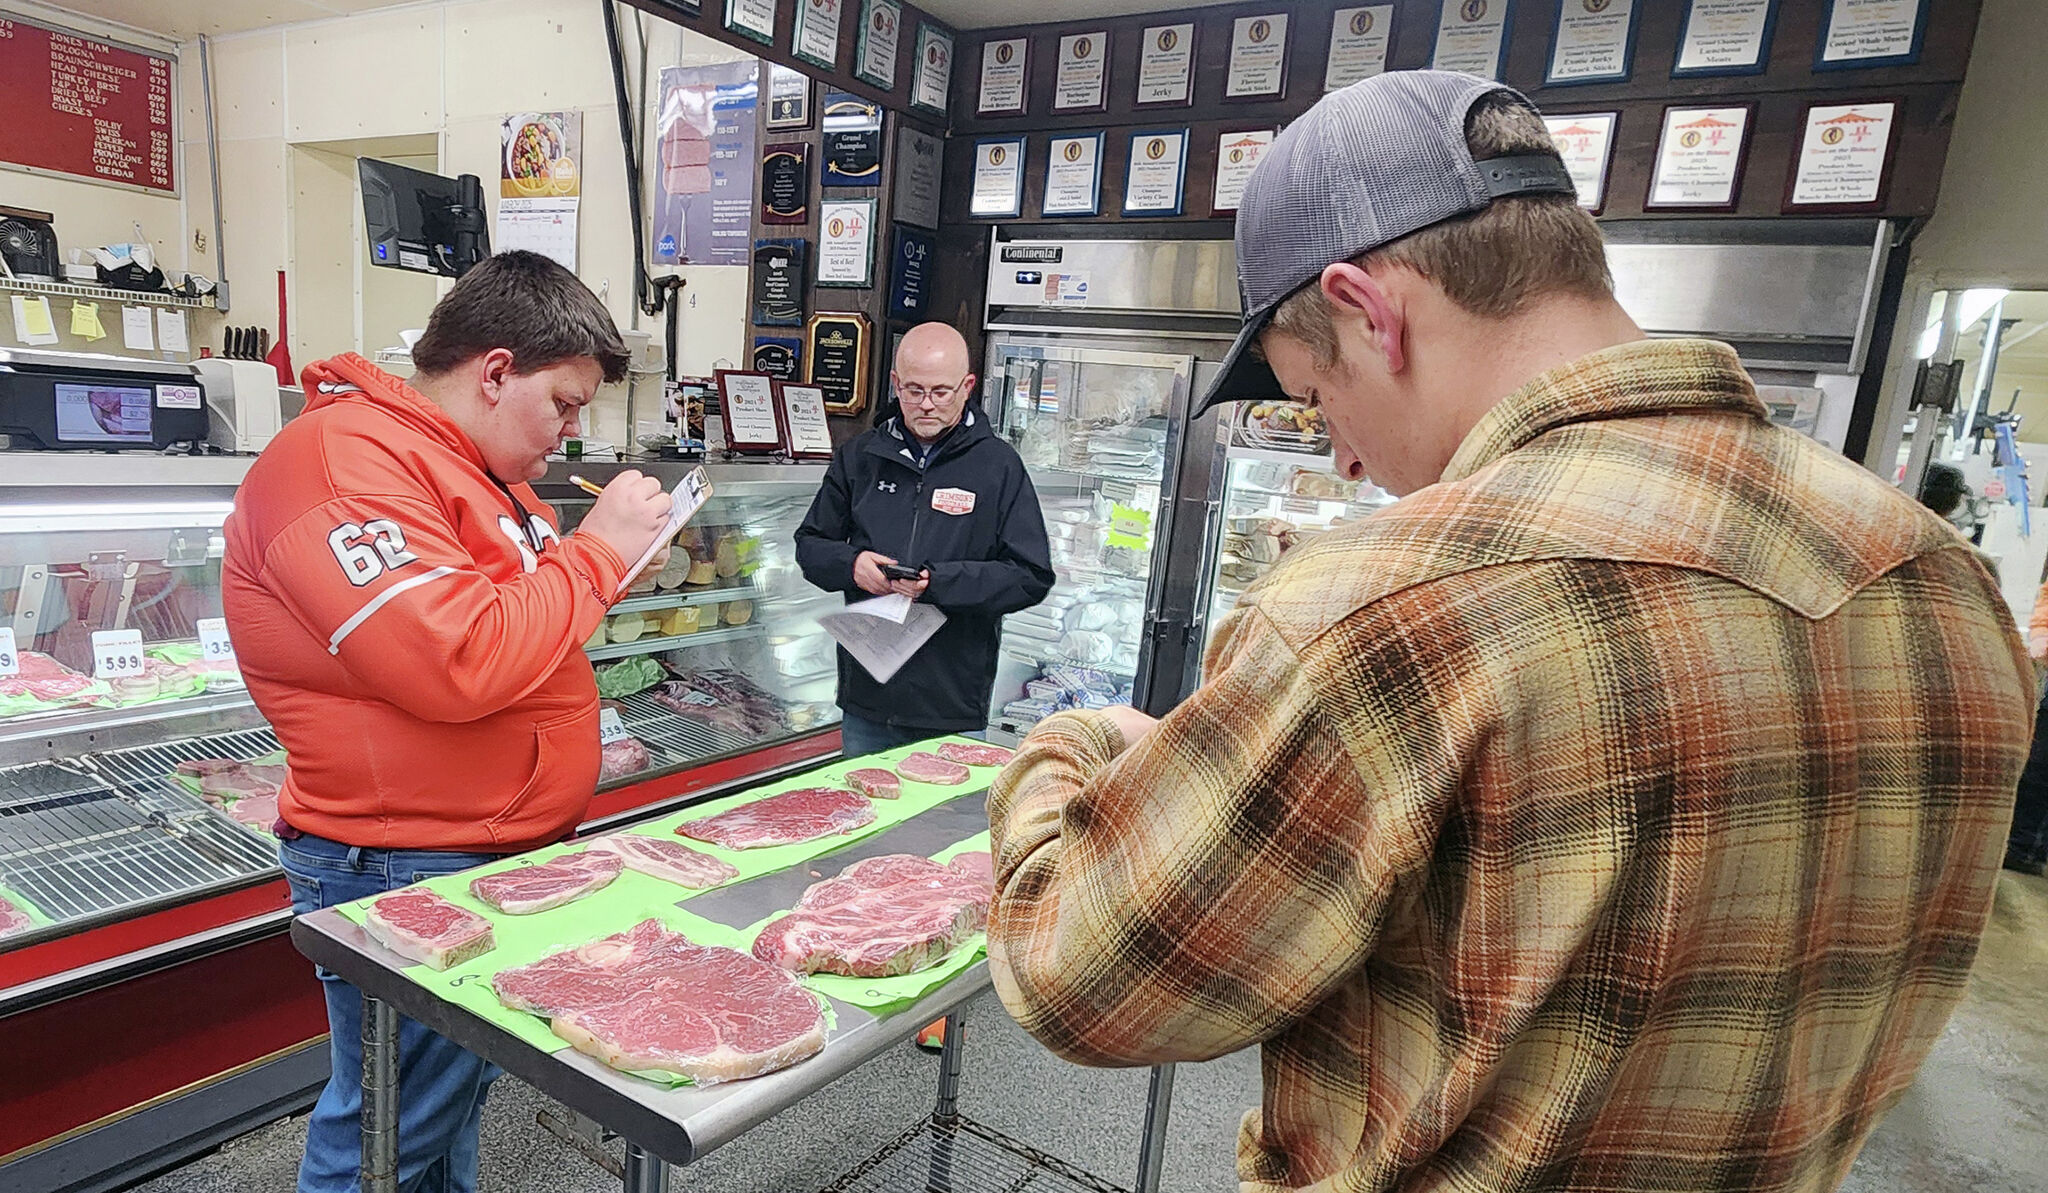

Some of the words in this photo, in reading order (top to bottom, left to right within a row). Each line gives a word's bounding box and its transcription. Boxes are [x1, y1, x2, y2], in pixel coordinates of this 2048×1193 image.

[50, 32, 83, 48] JONES
[87, 42, 110, 54] HAM
[1829, 39, 1857, 48] Cooked
[1858, 37, 1882, 45] Whole
[1883, 35, 1909, 43] Muscle
[50, 42, 95, 60] BOLOGNA
[1699, 47, 1742, 55] Luncheon
[1862, 46, 1891, 55] Product
[50, 51, 137, 79] BRAUNSCHWEIGER
[1706, 56, 1732, 64] Meats
[50, 61, 78, 73] HEAD
[83, 69, 121, 84] CHEESE
[1567, 66, 1590, 74] Snack
[51, 70, 90, 86] TURKEY
[149, 75, 167, 86] 679
[51, 86, 79, 98] DRIED
[84, 93, 109, 105] BEEF
[76, 84, 102, 97] LOAF
[150, 84, 167, 95] 779
[1152, 88, 1172, 97] Jerky
[53, 94, 82, 107] ROAST
[148, 93, 166, 103] 1099
[51, 102, 93, 118] CHEESES
[149, 101, 166, 111] 919
[94, 118, 122, 131] COLBY
[94, 126, 121, 138] SWISS
[841, 134, 862, 142] Grand
[94, 140, 124, 153] PEPPER
[95, 134, 137, 149] AMERICAN
[835, 143, 867, 152] Champion
[92, 155, 130, 169] COJACK
[93, 148, 144, 165] PROVOLONE
[95, 164, 134, 179] CHEDDAR
[658, 241, 676, 253] pork
[1005, 247, 1058, 259] Continental
[819, 338, 853, 347] JACKSONVILLE
[935, 491, 974, 503] CRIMSONS
[327, 519, 419, 587] 62
[211, 641, 232, 655] 3.5
